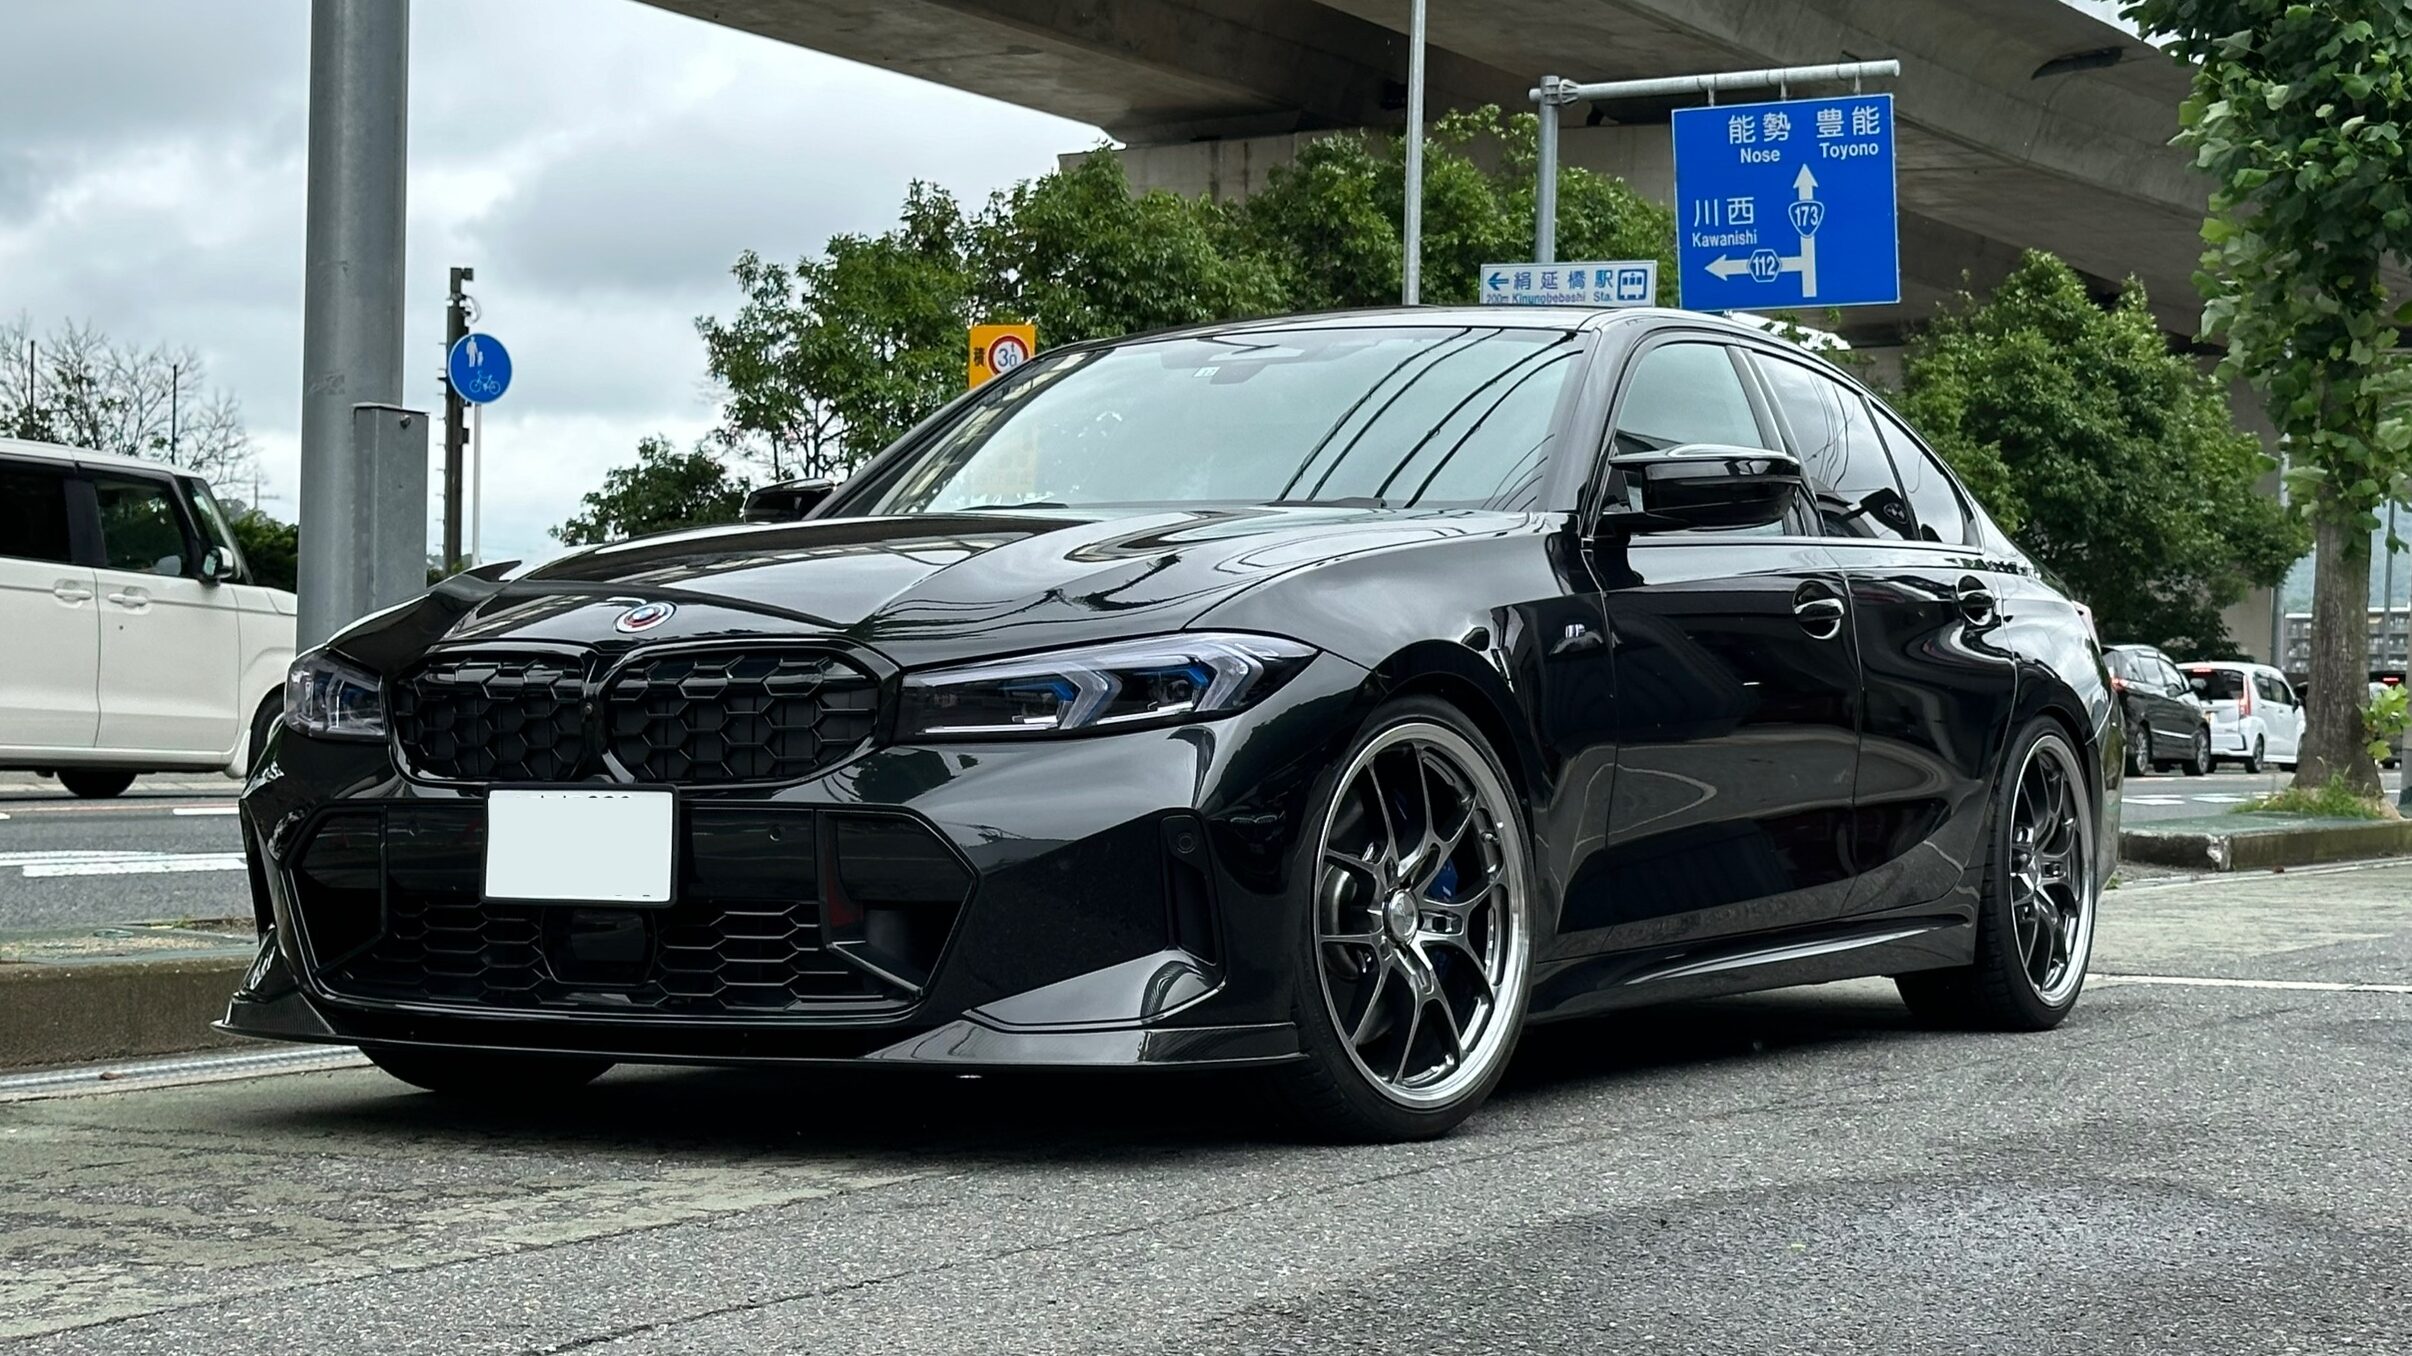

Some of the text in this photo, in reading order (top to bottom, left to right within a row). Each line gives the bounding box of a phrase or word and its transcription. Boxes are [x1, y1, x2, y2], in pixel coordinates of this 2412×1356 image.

[1728, 105, 1880, 145] 能勢 豊能
[1740, 142, 1879, 164] Nose Toyono
[1693, 197, 1755, 227] 川西
[1794, 206, 1819, 228] 173
[1692, 230, 1757, 248] Kawanishi
[1752, 256, 1776, 277] 112
